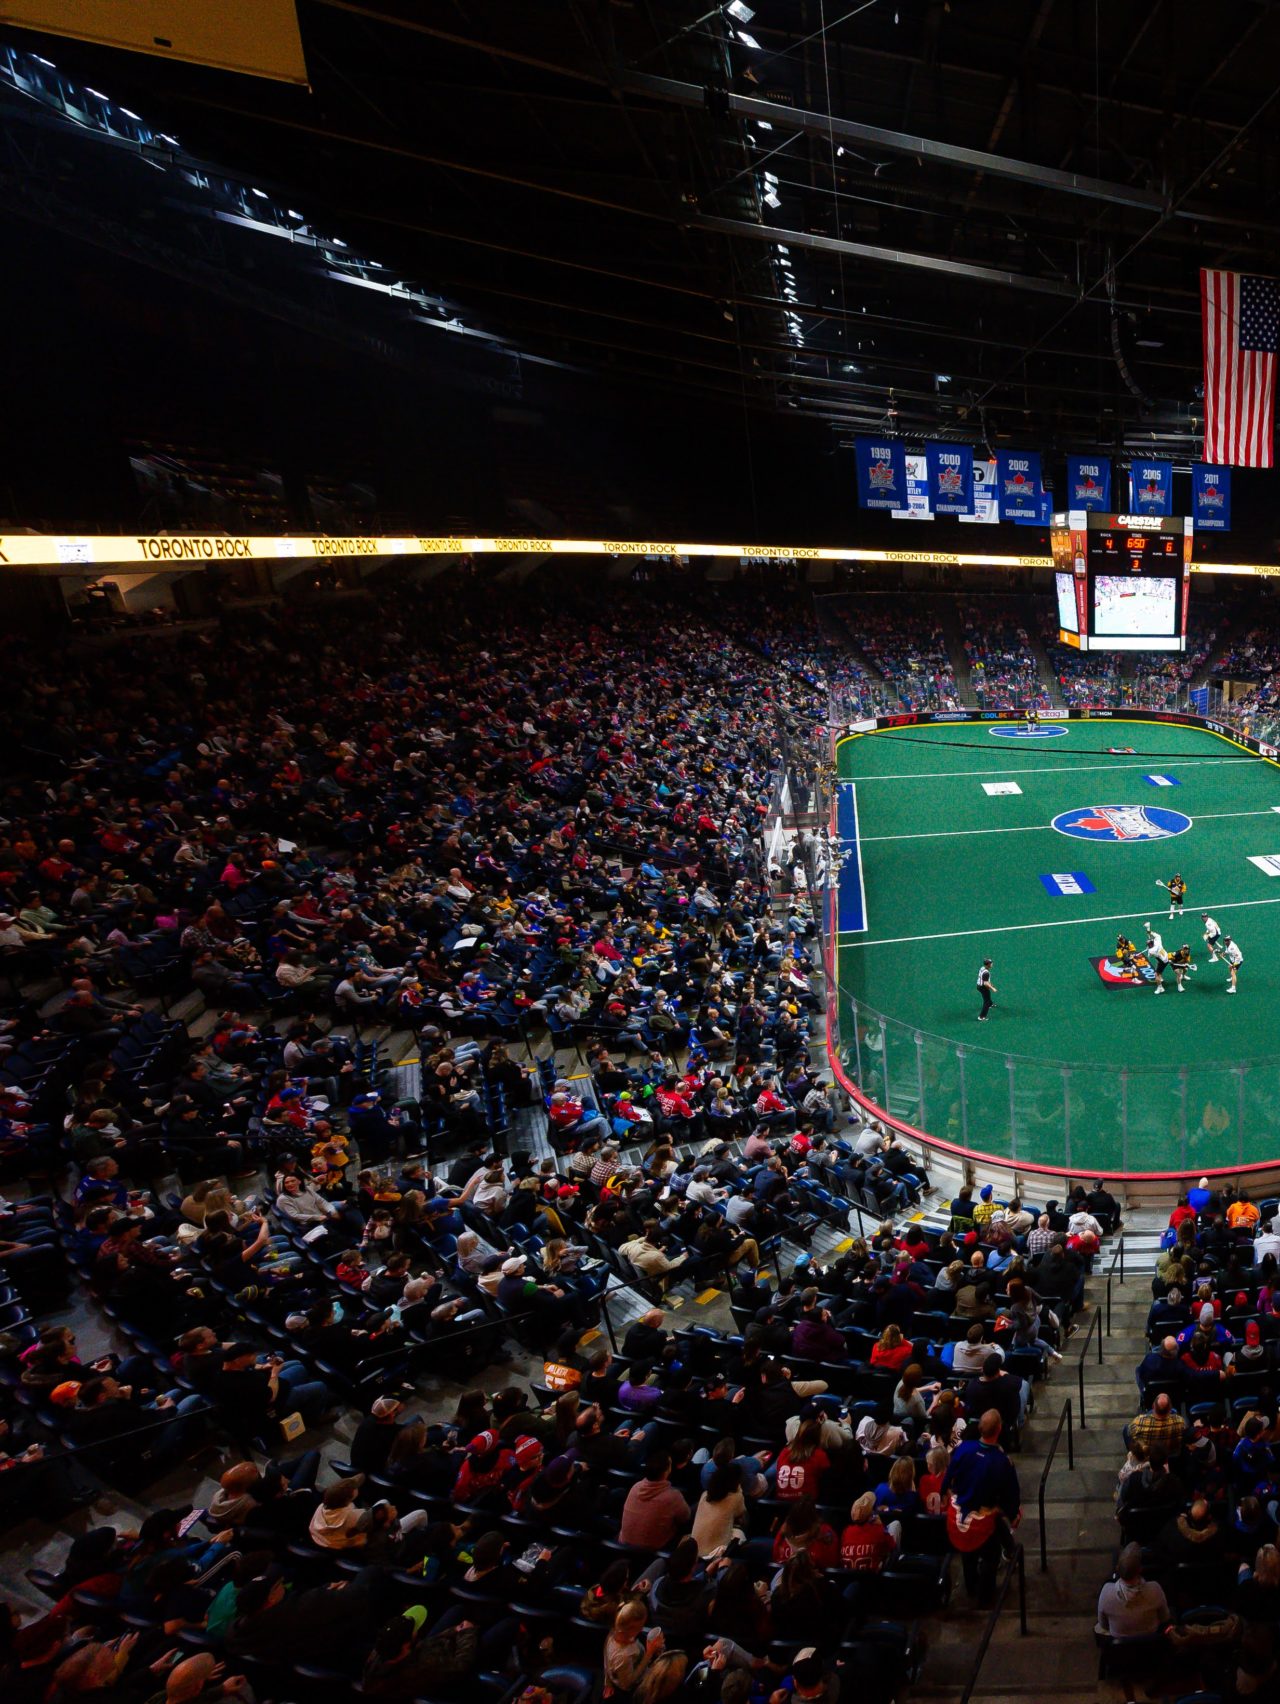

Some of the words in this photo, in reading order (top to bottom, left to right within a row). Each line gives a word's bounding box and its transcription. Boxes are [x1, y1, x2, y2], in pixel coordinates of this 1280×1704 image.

[870, 447, 892, 460] 1999
[938, 453, 961, 466] 2000
[1008, 459, 1030, 472] 2002
[1079, 465, 1099, 477] 2003
[1142, 469, 1162, 481] 2005
[1204, 473, 1219, 485] 2011
[1117, 515, 1164, 527] CARSTAR
[137, 538, 214, 560] TORONTO
[215, 539, 253, 557] ROCK
[311, 539, 355, 556] TORONTO
[356, 539, 379, 554] ROCK
[418, 539, 447, 552] TORONTO
[447, 540, 463, 552] ROCK
[494, 539, 528, 552] TORONTO
[529, 540, 552, 551] ROCK
[602, 542, 648, 553] TORONTO
[649, 543, 677, 554] ROCK
[1106, 539, 1113, 549] 4
[1127, 538, 1145, 549] 6:50
[1165, 542, 1173, 552] 6
[741, 546, 791, 557] TORONTO
[792, 548, 820, 558] ROCK
[884, 552, 931, 562] TORONTO
[932, 553, 959, 563] ROCK
[1018, 557, 1055, 567] TORONT
[887, 714, 918, 727] TSN
[980, 712, 1013, 720] COOLBET
[841, 1545, 855, 1557] OCK
